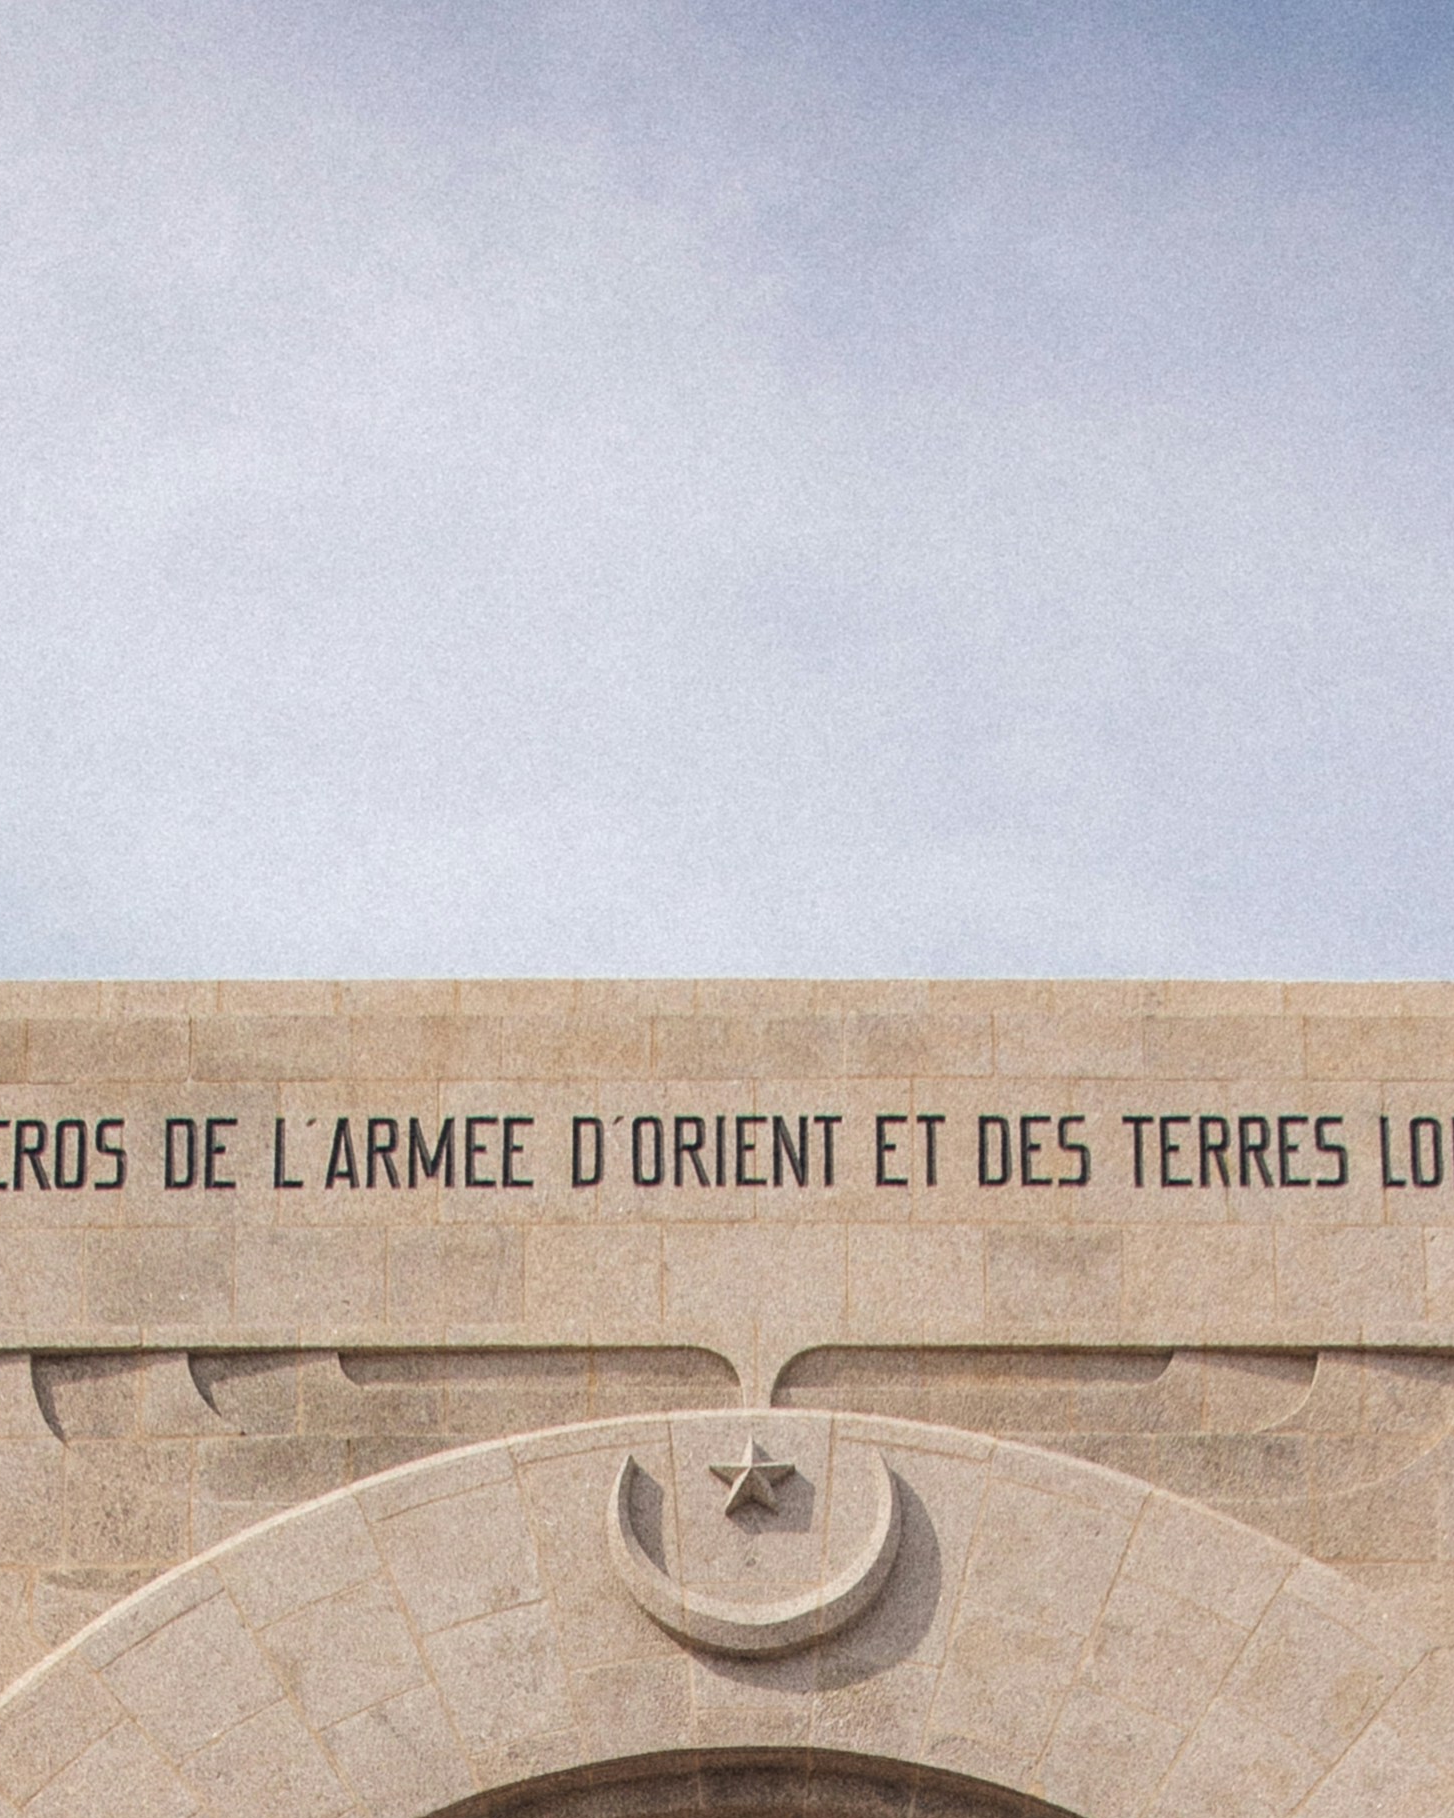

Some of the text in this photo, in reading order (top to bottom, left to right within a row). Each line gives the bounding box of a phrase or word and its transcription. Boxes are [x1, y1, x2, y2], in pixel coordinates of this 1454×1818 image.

[164, 1117, 239, 1190] DE
[273, 1116, 535, 1190] L'ARMEE
[571, 1114, 843, 1189] D'ORIENT
[875, 1114, 946, 1187] ET
[977, 1114, 1089, 1187] DES
[1121, 1115, 1348, 1188] TERRES
